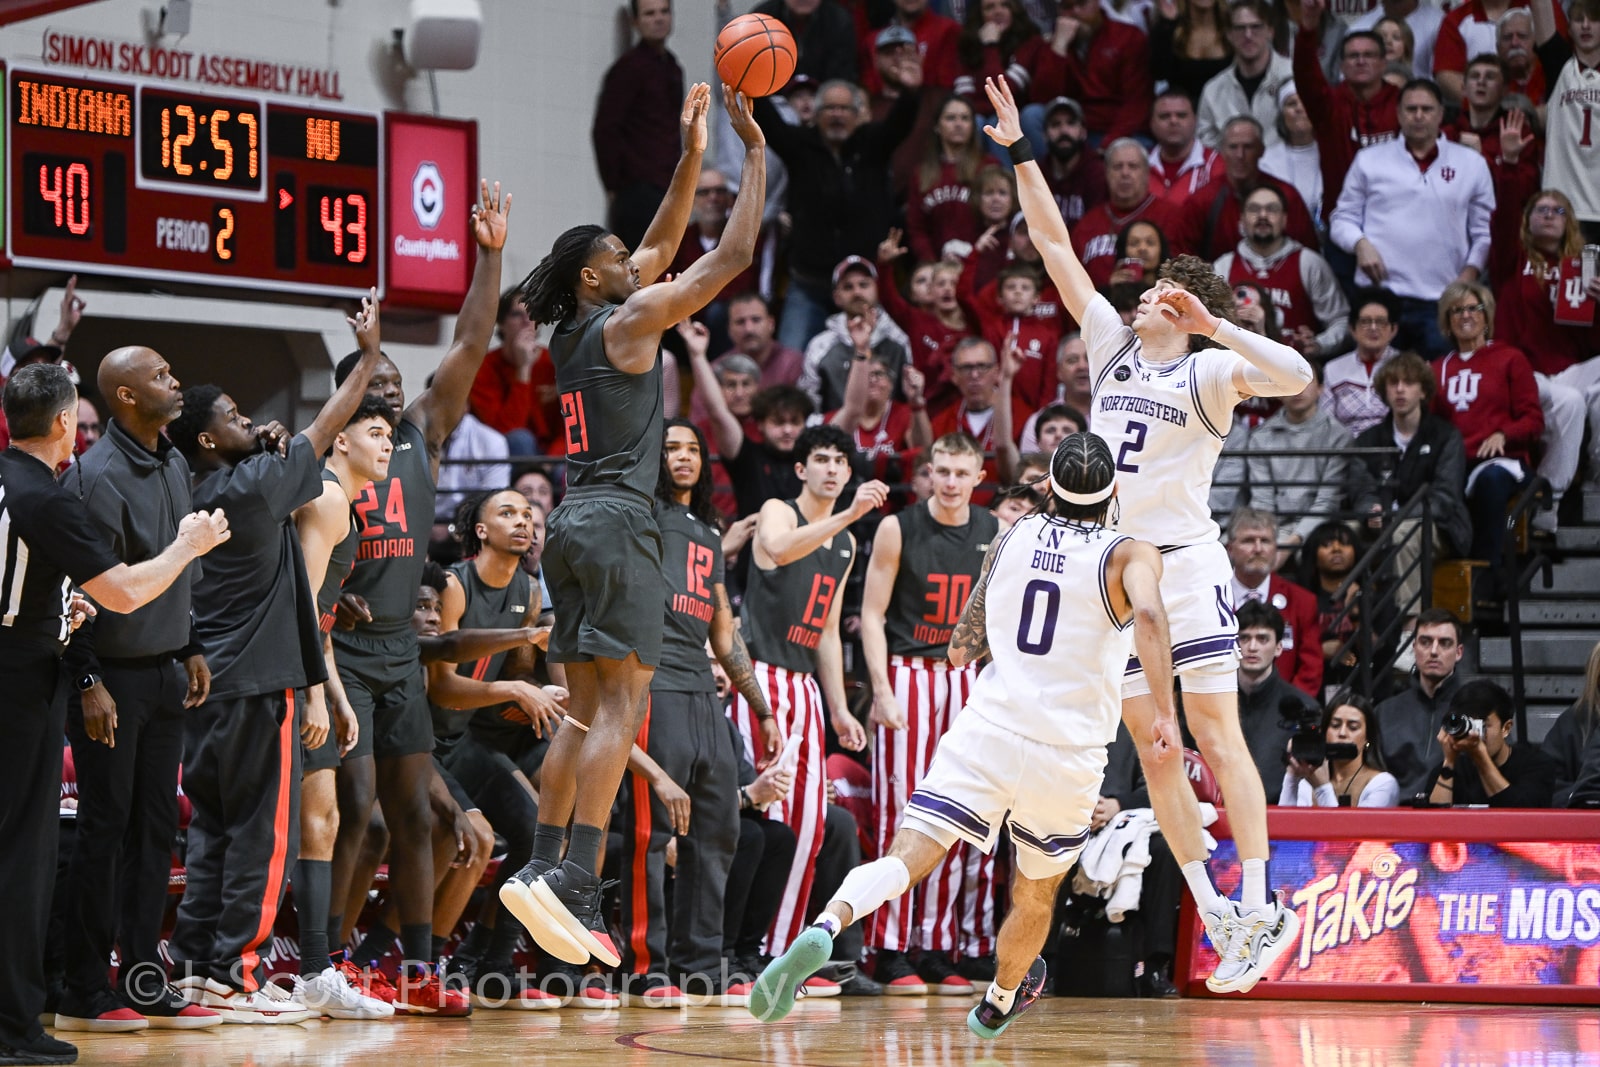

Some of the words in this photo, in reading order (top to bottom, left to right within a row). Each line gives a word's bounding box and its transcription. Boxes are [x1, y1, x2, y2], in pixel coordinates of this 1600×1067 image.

[48, 33, 113, 71] SIMON
[119, 42, 194, 81] SKJODT
[196, 55, 294, 93] ASSEMBLY
[297, 66, 344, 100] HALL
[19, 81, 131, 137] INDIANA
[161, 105, 258, 180] 12:57
[306, 118, 340, 161] NU
[40, 163, 89, 235] 40
[156, 217, 210, 253] PERIOD
[216, 208, 234, 260] 2
[320, 194, 366, 263] 43
[561, 391, 589, 455] 21
[1099, 395, 1188, 428] NORTHWESTERN
[1116, 420, 1148, 474] 2
[353, 477, 408, 537] 24
[687, 541, 714, 599] 12
[1031, 551, 1066, 574] BUIE
[802, 573, 836, 629] 13
[923, 573, 972, 625] 30
[1017, 579, 1060, 656] 0
[913, 623, 953, 645] INDIA
[1293, 853, 1418, 969] Takis
[1439, 893, 1498, 933] THE
